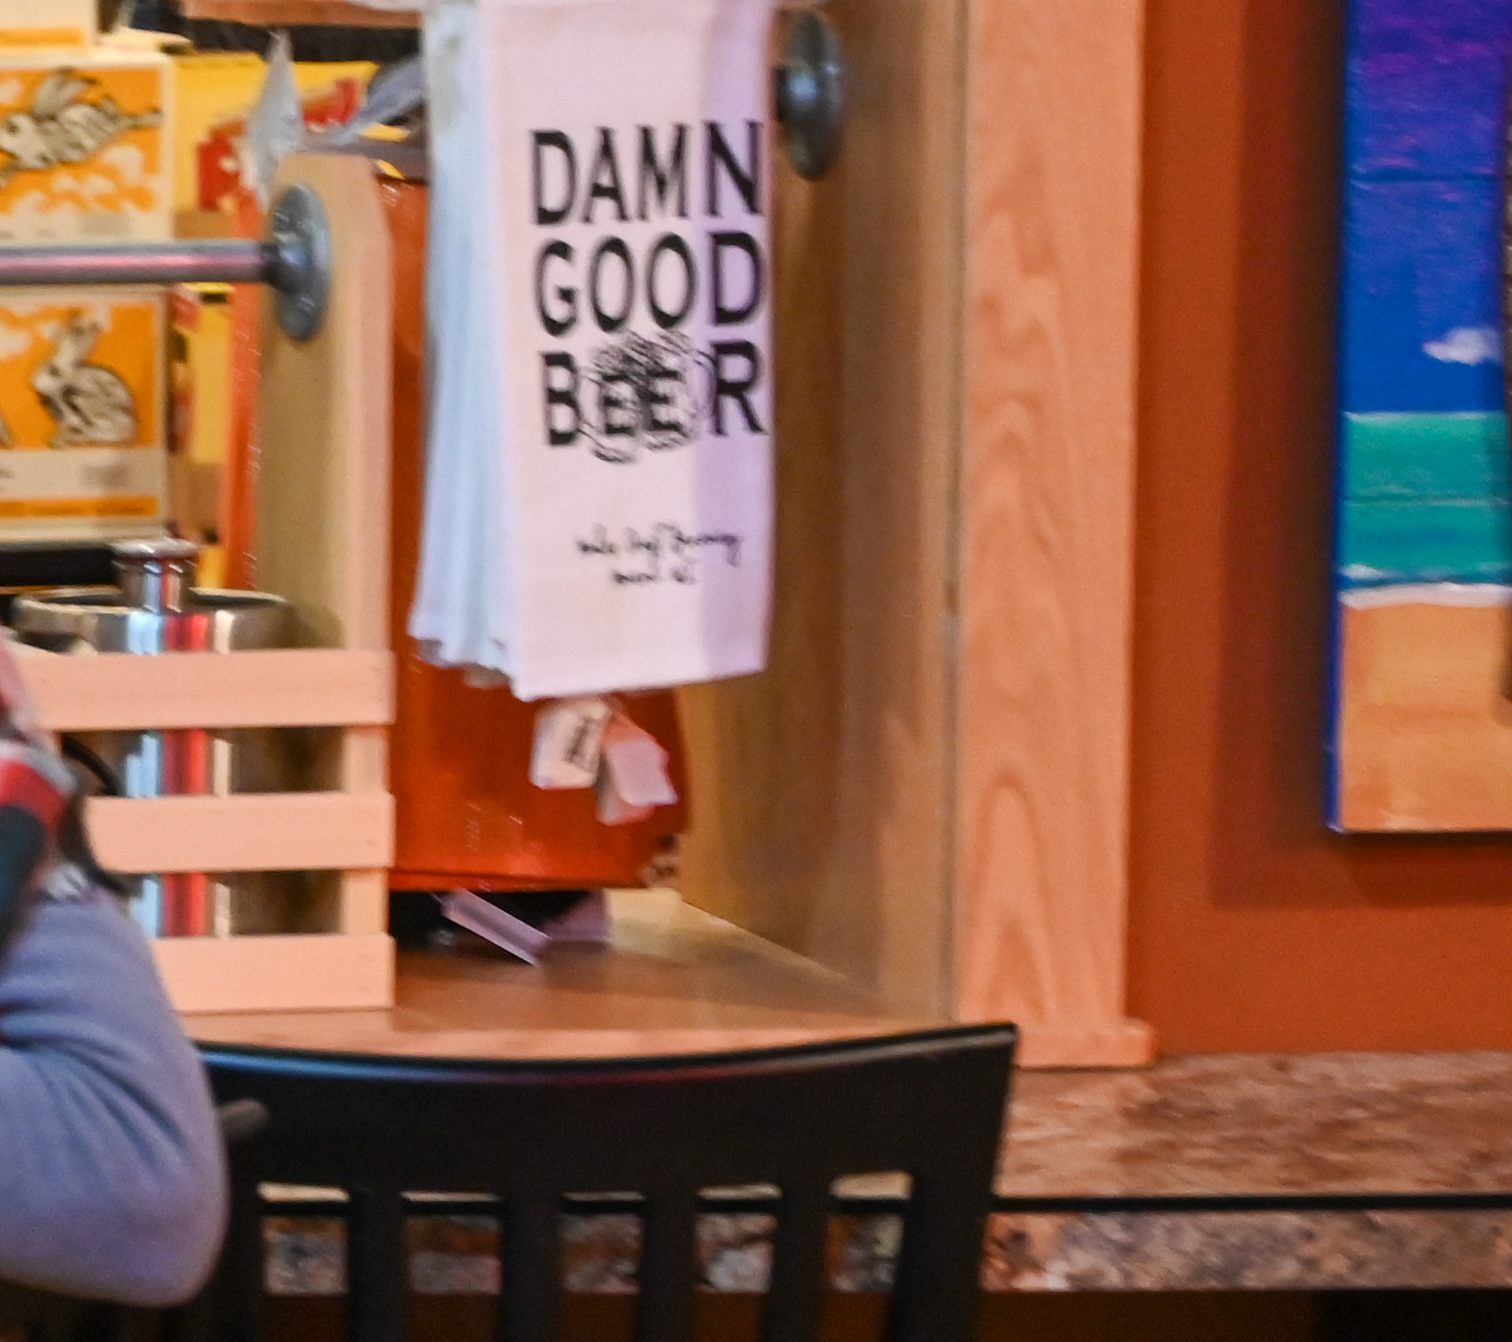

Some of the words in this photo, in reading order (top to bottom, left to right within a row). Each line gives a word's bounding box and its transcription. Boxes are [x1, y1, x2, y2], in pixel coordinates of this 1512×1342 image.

[529, 119, 763, 226] DAMN
[534, 232, 763, 335] GOOD
[539, 341, 765, 447] BEER
